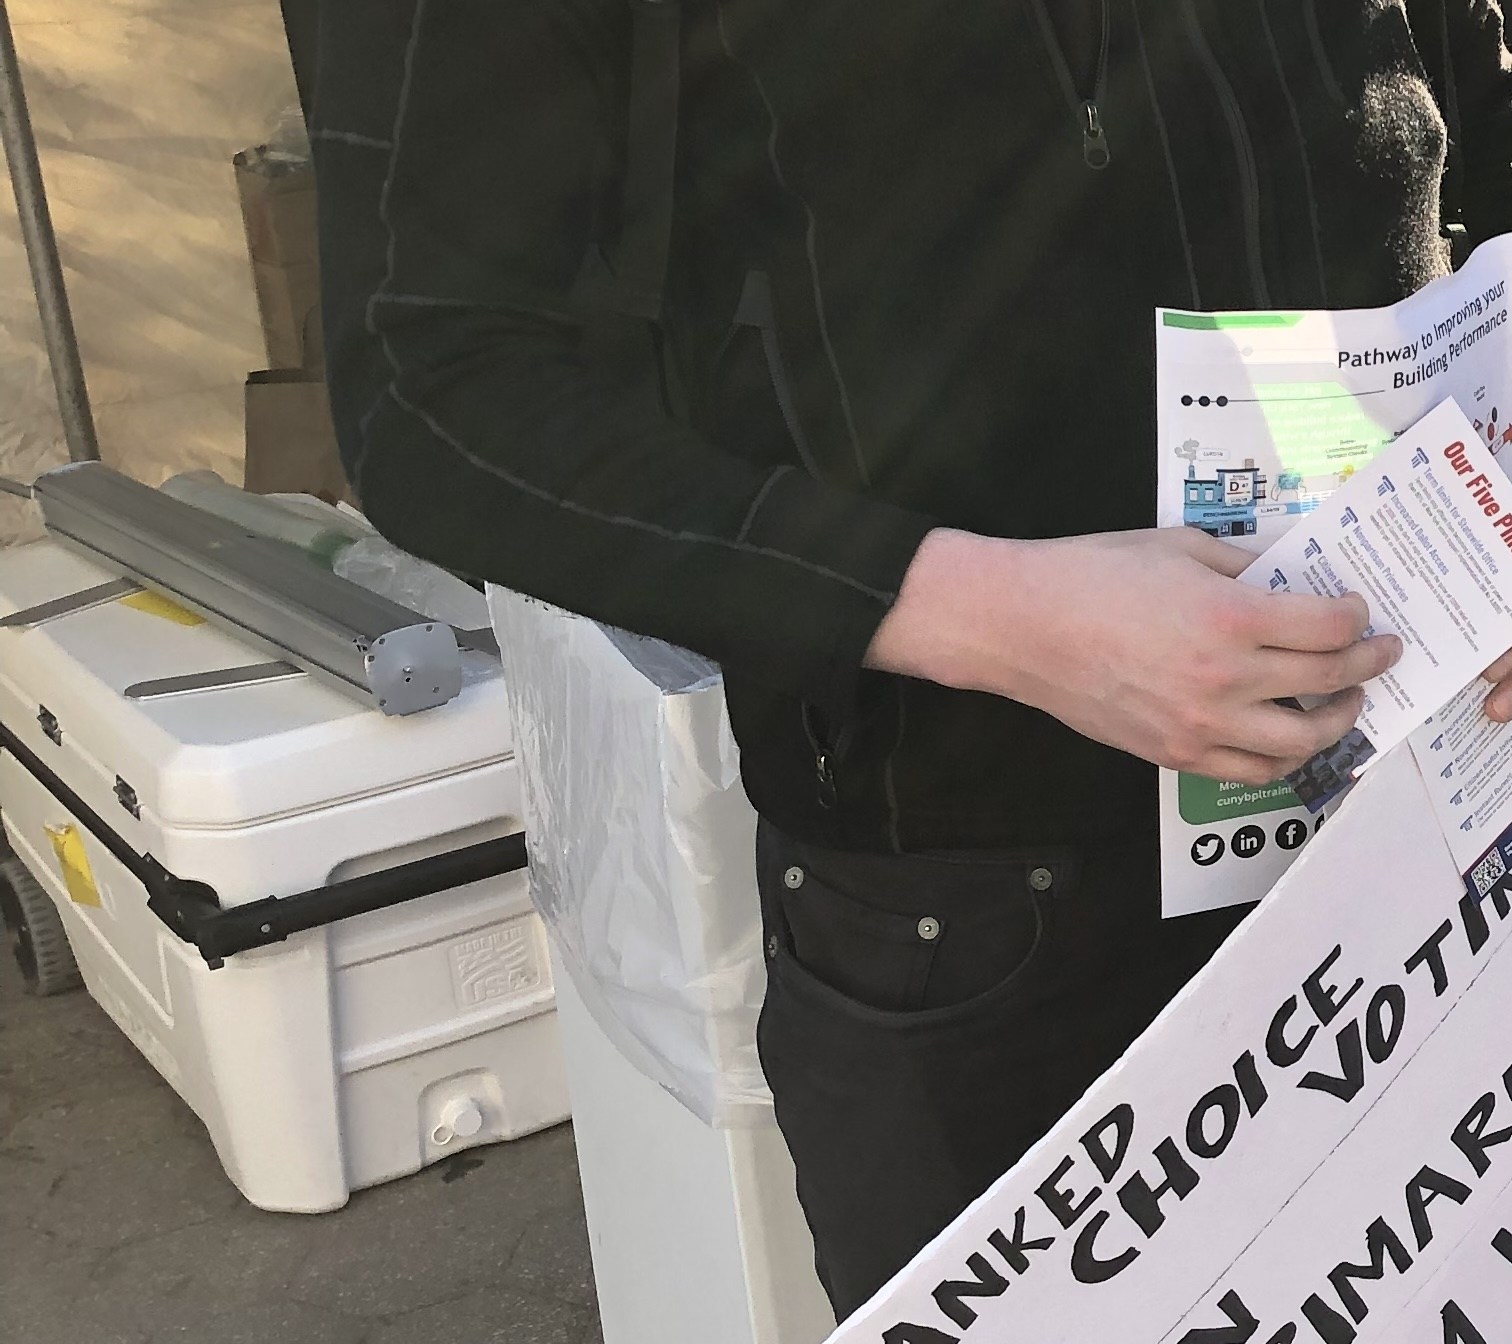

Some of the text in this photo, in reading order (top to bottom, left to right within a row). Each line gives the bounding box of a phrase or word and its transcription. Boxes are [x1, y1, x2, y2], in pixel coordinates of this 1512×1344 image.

[1338, 280, 1506, 368] Pathway to Improving your
[1393, 308, 1508, 389] Building Performance
[1444, 441, 1474, 476] Our
[1466, 474, 1500, 516] Five
[1353, 525, 1384, 569] Nonpartisan
[1382, 567, 1408, 602] Primaries
[1390, 493, 1419, 530] Increased
[1415, 528, 1433, 551] Ballot
[1429, 549, 1449, 575] Access
[1450, 506, 1460, 519] for
[1457, 518, 1484, 554] Statewide
[1481, 552, 1499, 575] Office
[1217, 786, 1296, 807] cunybpltraini
[1071, 943, 1365, 1285] CHOICE
